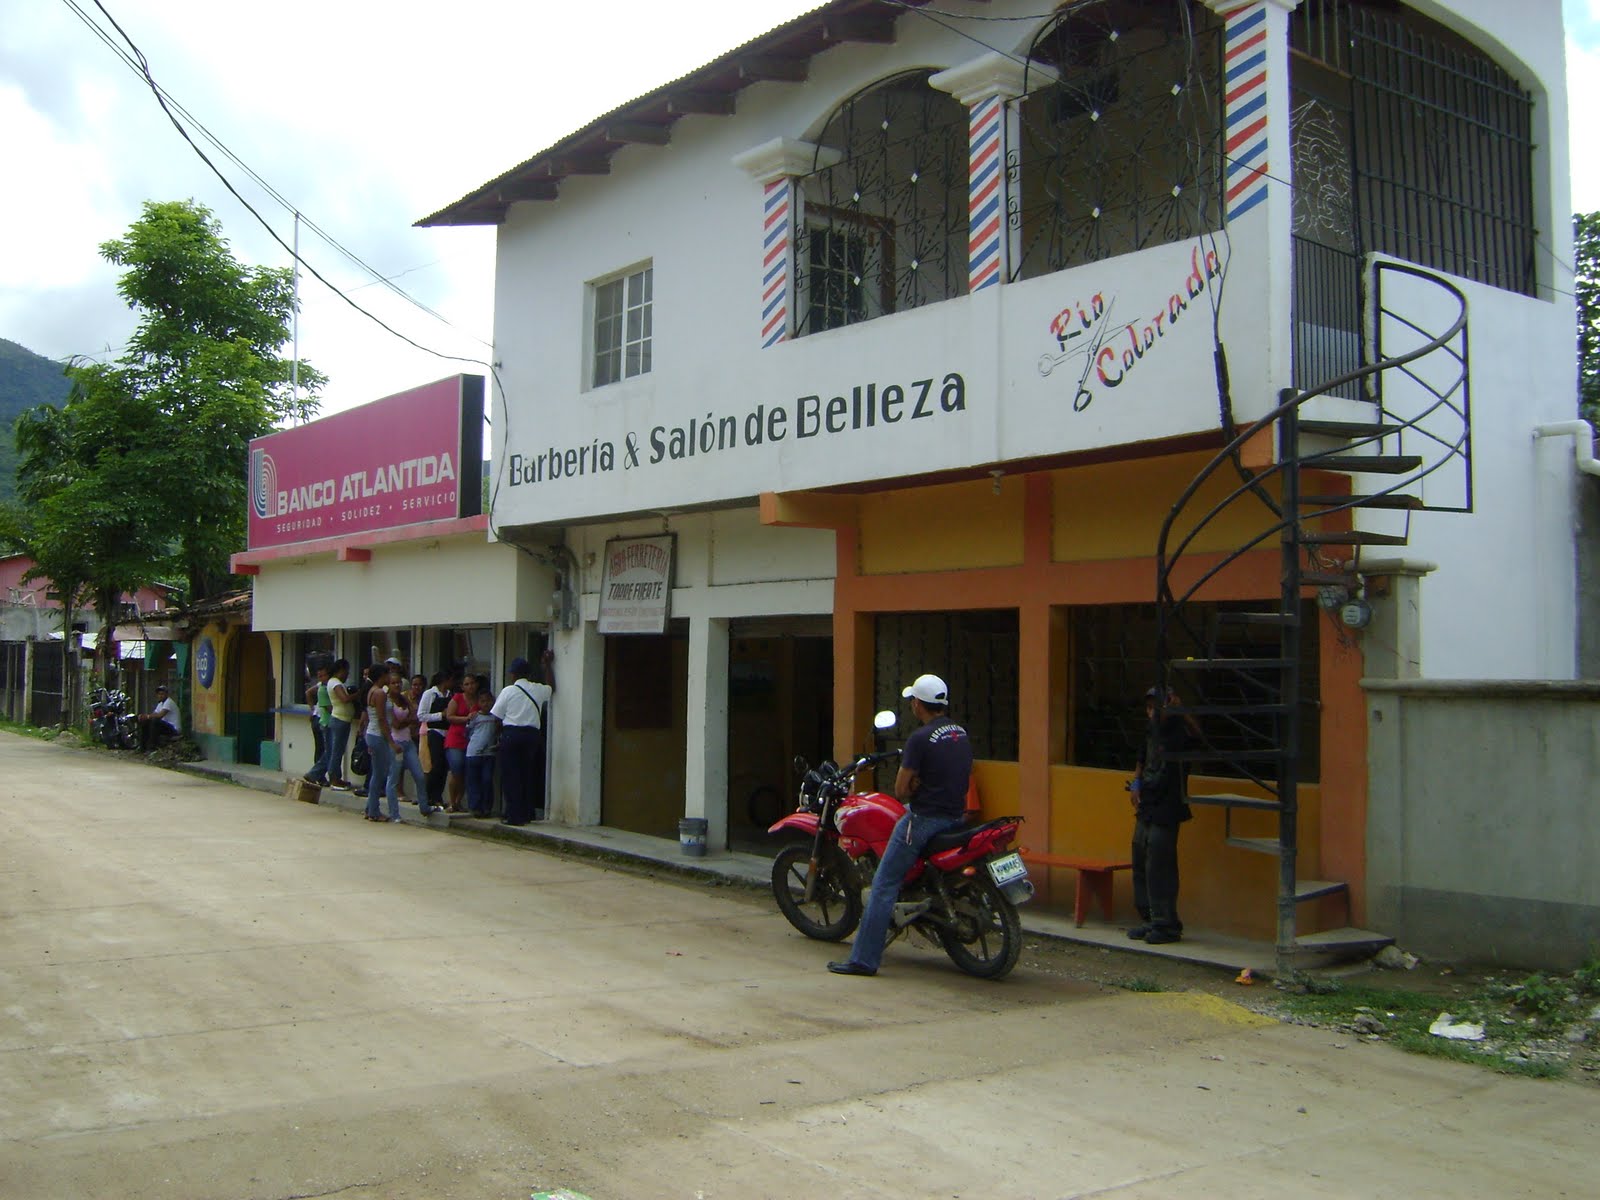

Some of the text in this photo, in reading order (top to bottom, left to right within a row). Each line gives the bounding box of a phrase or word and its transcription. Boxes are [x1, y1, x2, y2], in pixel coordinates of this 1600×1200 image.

[1096, 246, 1221, 388] Colorado
[509, 371, 967, 487] Barbería & Salón de Belleza
[276, 491, 456, 534] SEGURIDAD SOLIDEZ SERVICIO
[277, 452, 456, 516] BANCO ATLANTIDA
